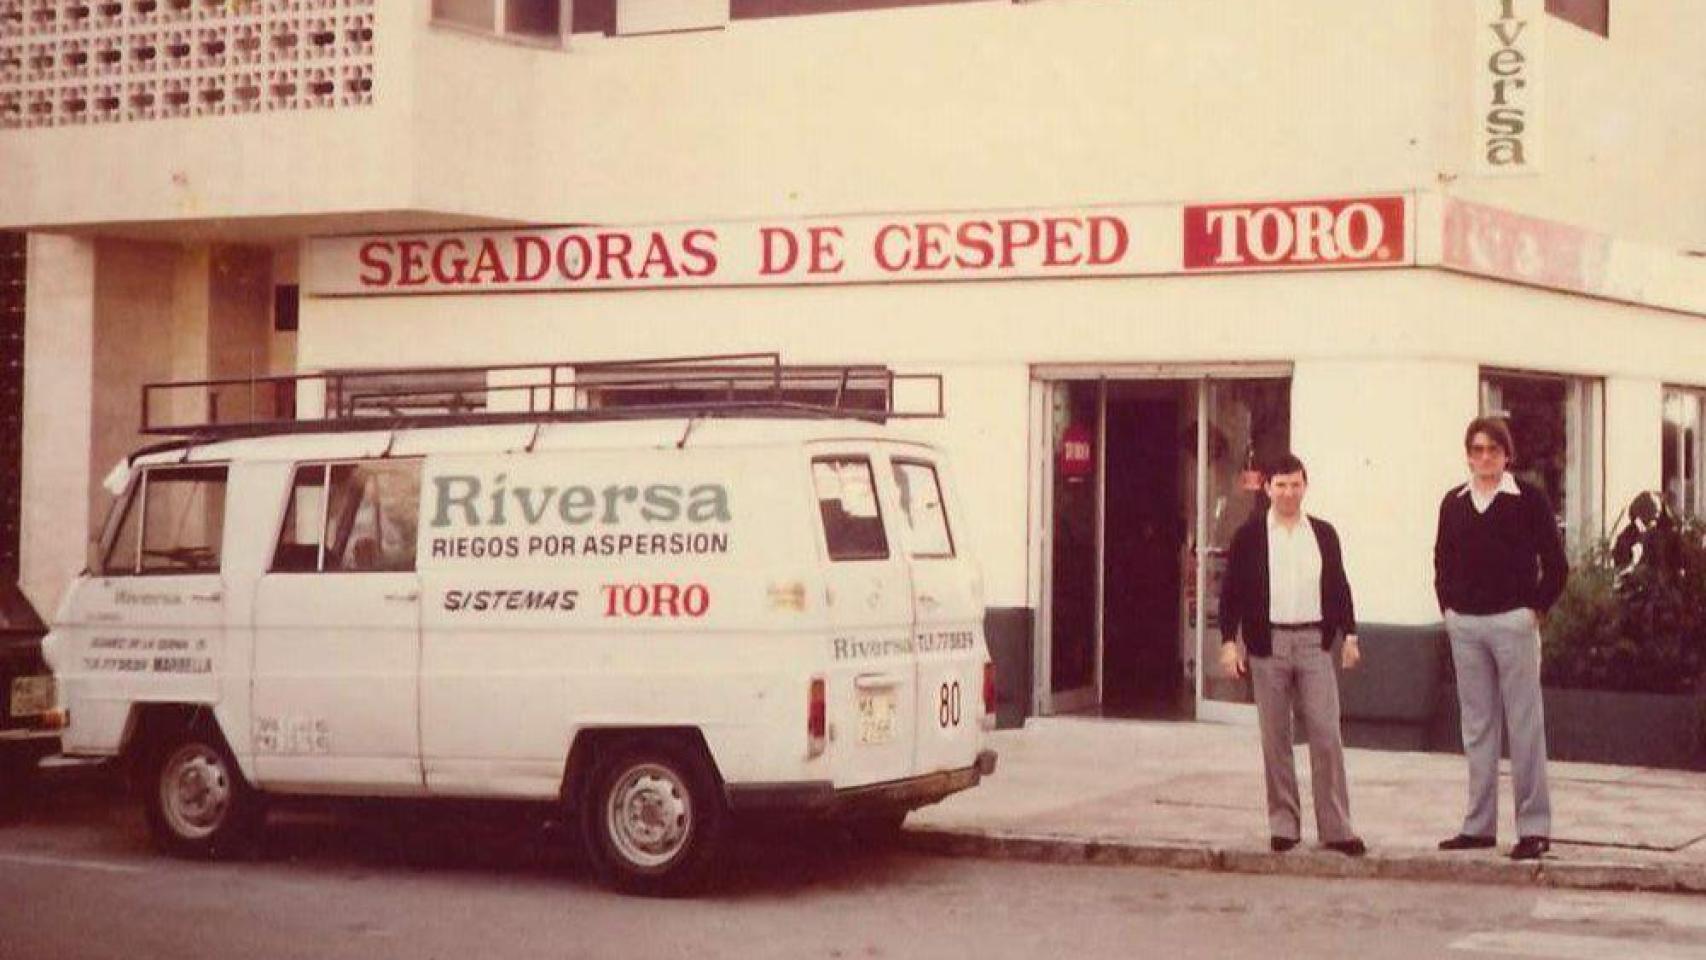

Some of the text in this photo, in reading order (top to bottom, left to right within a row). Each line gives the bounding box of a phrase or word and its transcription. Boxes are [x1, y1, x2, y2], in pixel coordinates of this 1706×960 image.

[358, 229, 719, 288] SEGADORAS
[758, 225, 845, 277] DE
[874, 216, 1128, 272] CESPED
[433, 534, 727, 558] RIEGOS POR ASPERSION
[445, 584, 709, 618] SISTEMAS TORO
[940, 681, 960, 728] 80
